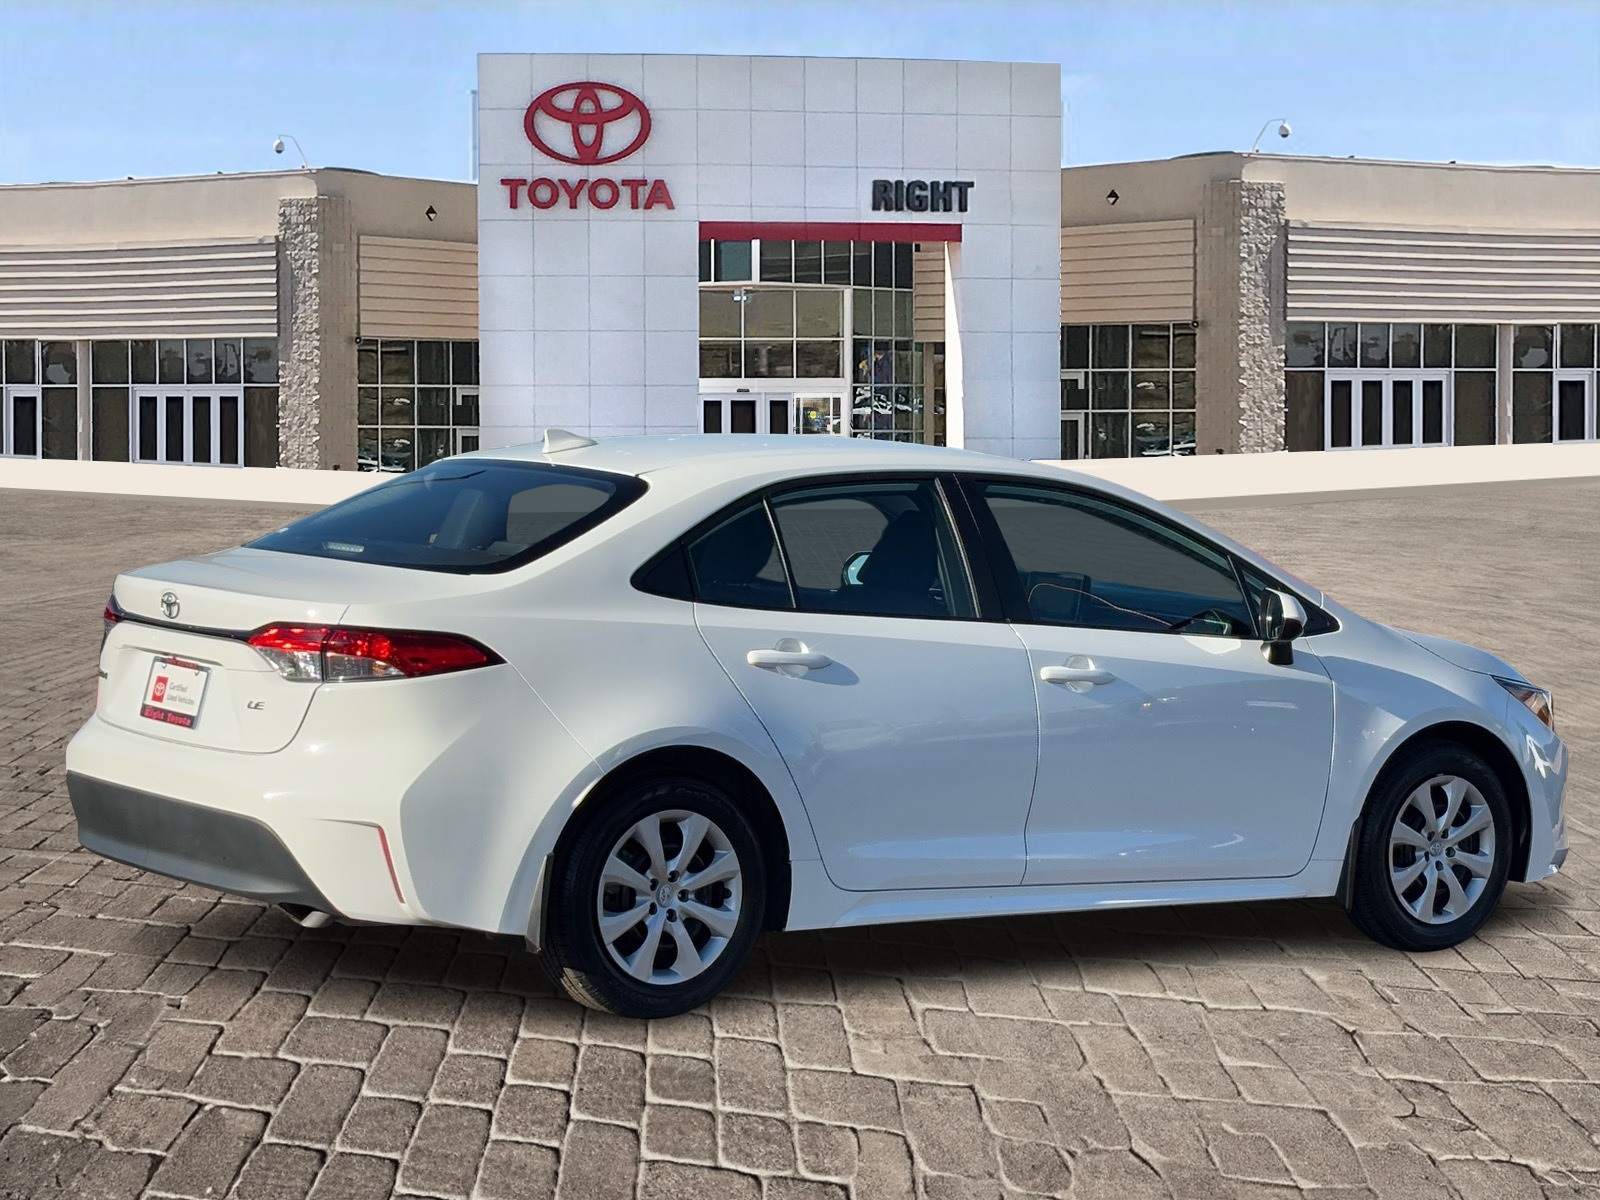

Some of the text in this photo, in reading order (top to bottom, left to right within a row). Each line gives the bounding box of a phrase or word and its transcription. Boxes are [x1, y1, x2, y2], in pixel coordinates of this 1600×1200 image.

[501, 178, 675, 210] TOYOTA
[871, 179, 975, 212] RIGHT
[144, 707, 192, 726] Right Toyota
[247, 700, 265, 710] LE
